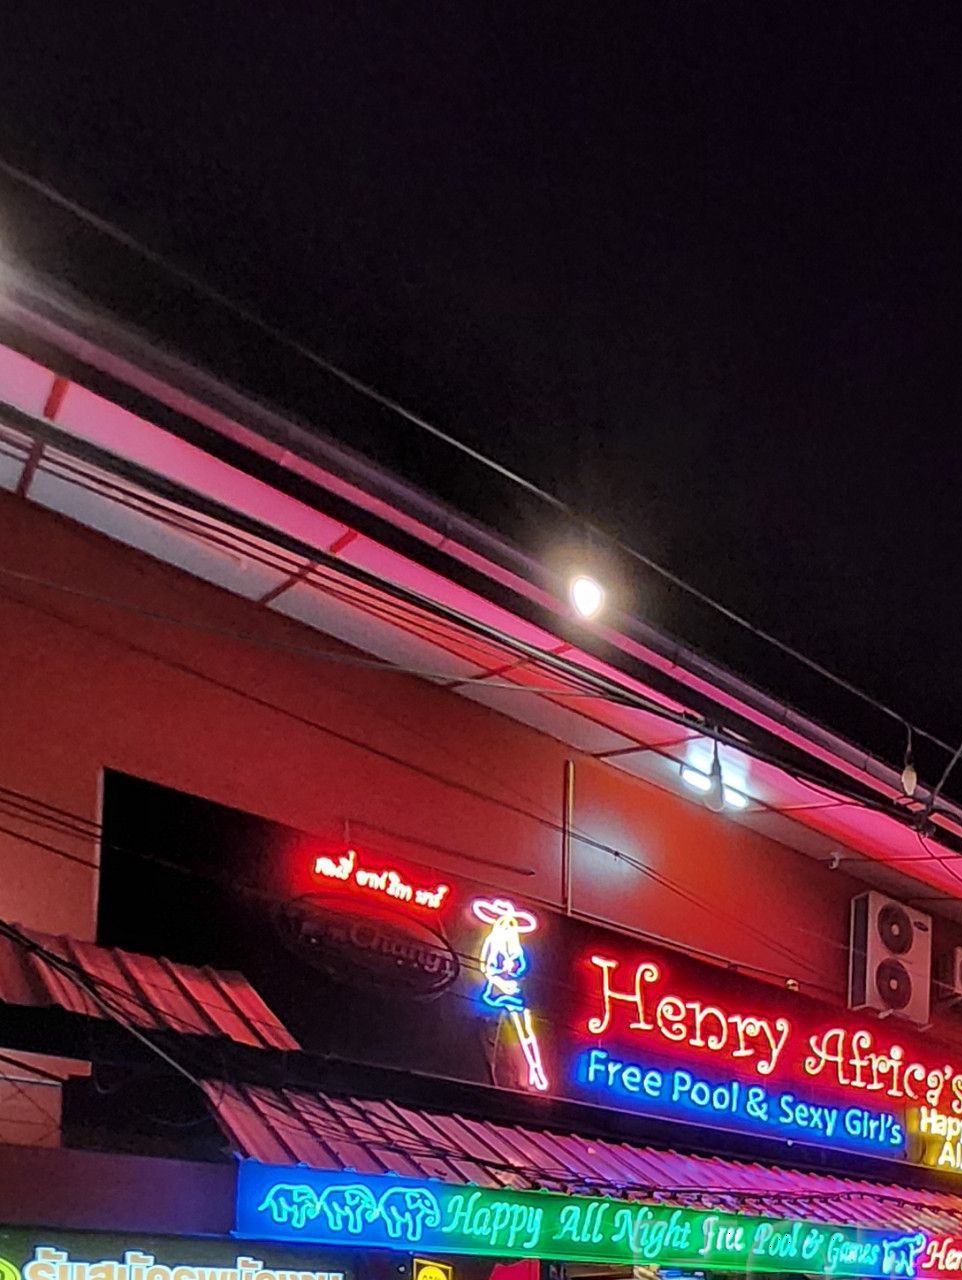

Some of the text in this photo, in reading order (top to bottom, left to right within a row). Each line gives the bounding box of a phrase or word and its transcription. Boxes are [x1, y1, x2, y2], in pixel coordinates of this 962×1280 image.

[587, 955, 789, 1074] Henry
[587, 1049, 662, 1097] Free
[672, 1070, 738, 1112] Pool
[746, 1087, 769, 1121] &
[779, 1094, 837, 1137] Sexy
[442, 1192, 543, 1249] Happy
[553, 1201, 609, 1243] All
[611, 1206, 691, 1258] Night
[698, 1215, 746, 1256] Free
[753, 1221, 803, 1258] Pool
[802, 1228, 824, 1259] &
